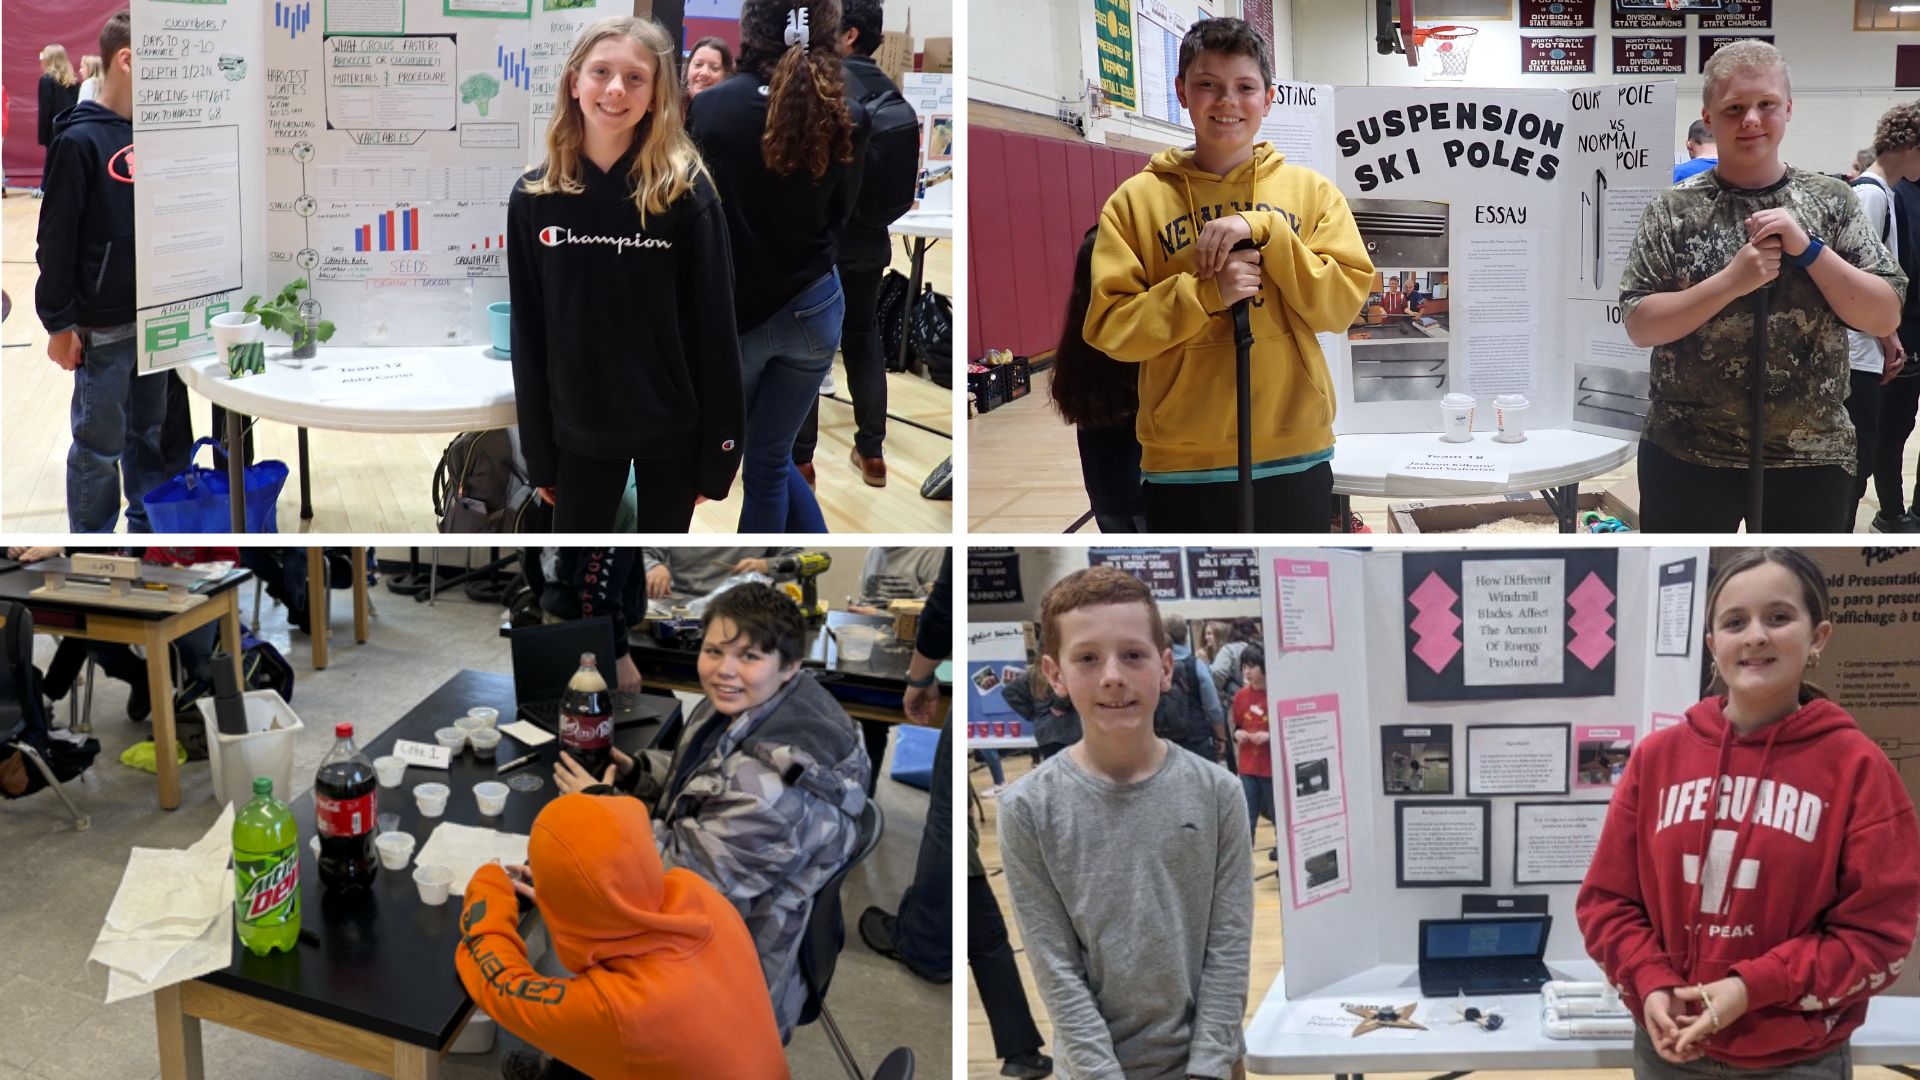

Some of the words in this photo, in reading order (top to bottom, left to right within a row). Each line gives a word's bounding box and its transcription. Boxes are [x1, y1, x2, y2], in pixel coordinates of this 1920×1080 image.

[1703, 20, 1725, 28] STATE
[360, 40, 394, 52] GROWS
[141, 66, 177, 79] DEPTH
[1101, 57, 1129, 80] VERMONT
[1528, 64, 1549, 72] STATE
[1550, 64, 1587, 72] CHAMPIONS
[1616, 65, 1640, 73] STATE
[139, 89, 189, 104] SPACING
[1272, 83, 1317, 106] STiNG
[1572, 90, 1601, 111] OUR
[1336, 102, 1564, 157] SUSPENSION
[356, 131, 411, 146] VARIABLES
[1353, 147, 1422, 192] SKI
[1442, 139, 1561, 182] POLES
[1475, 205, 1527, 225] ESSAY
[539, 225, 673, 255] Champion
[1476, 575, 1501, 587] How
[1503, 574, 1551, 587] Different
[1487, 590, 1539, 603] Windmill
[1477, 607, 1514, 620] Blades
[1517, 607, 1550, 619] Affect
[1479, 625, 1500, 637] The
[1504, 625, 1549, 637] Amount
[1485, 640, 1501, 653] Of
[1503, 640, 1543, 655] Energy
[1488, 656, 1539, 670] Produced
[1656, 774, 1823, 843] LIFEGUARD
[1708, 924, 1755, 938] PEAK
